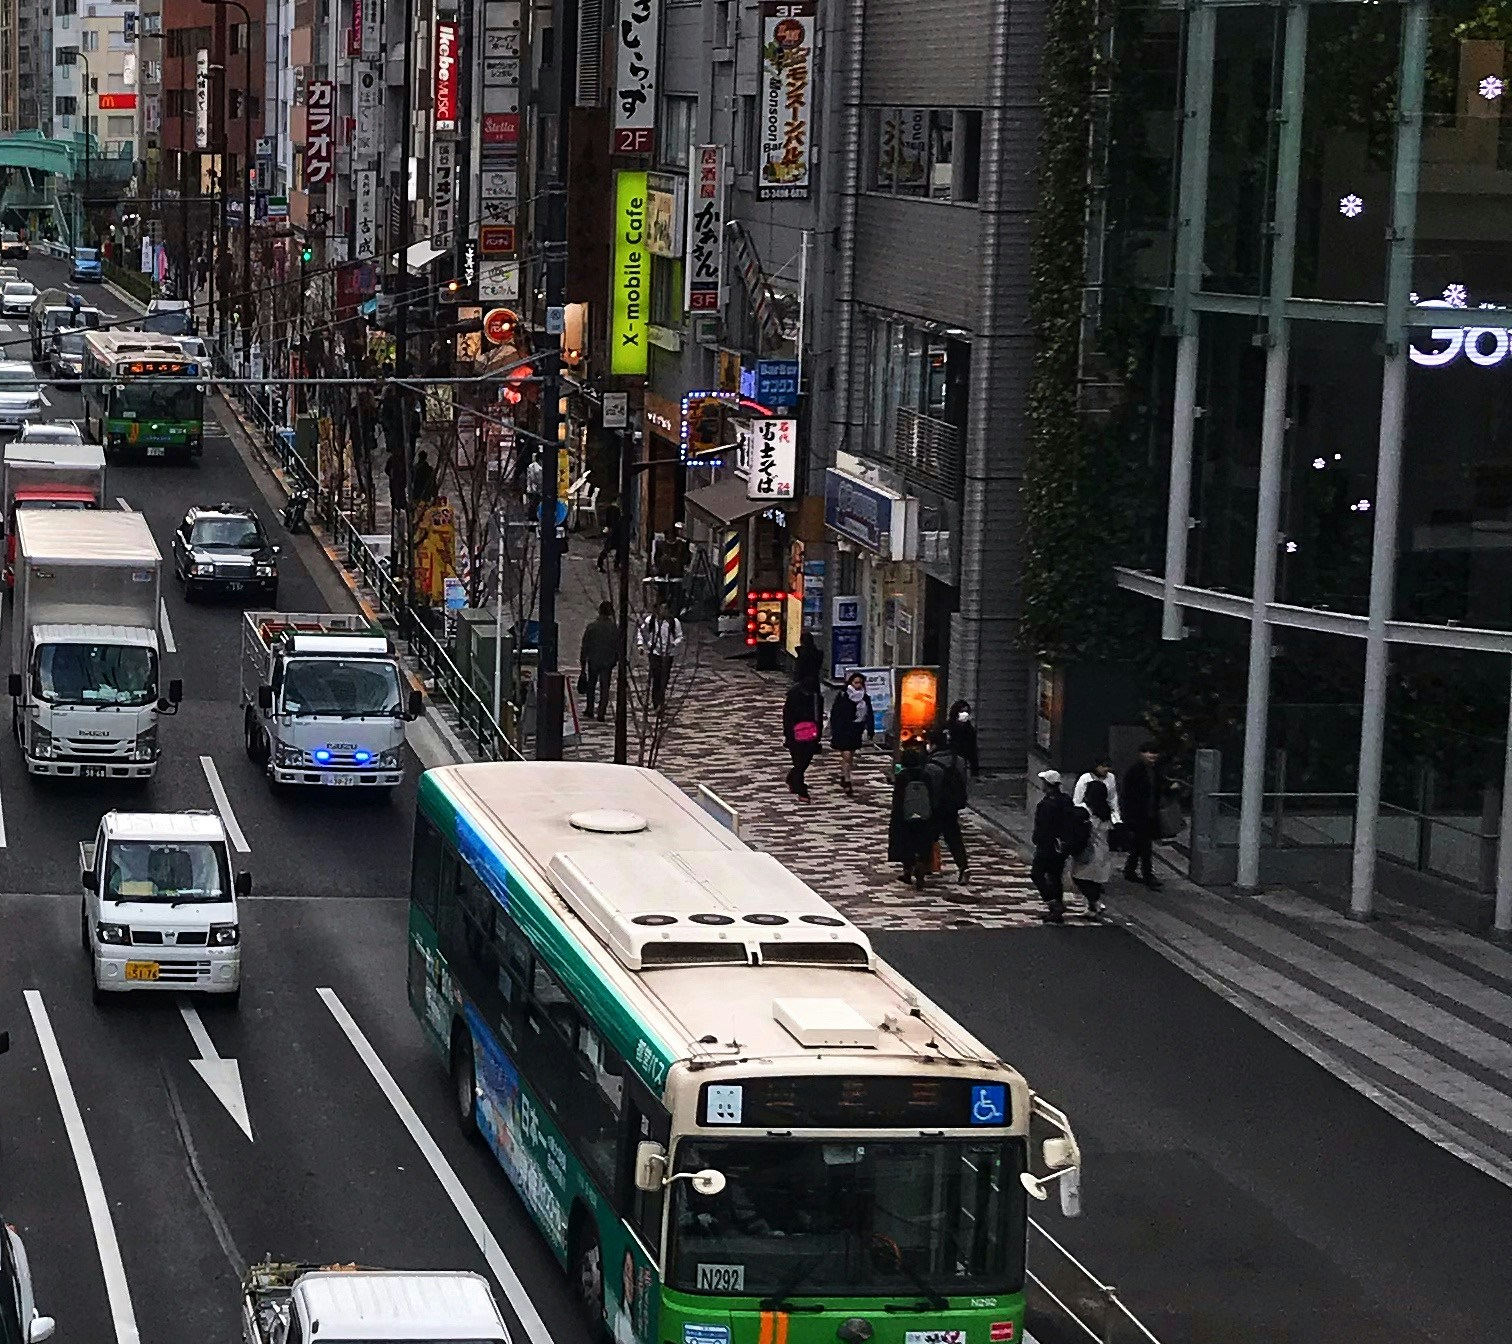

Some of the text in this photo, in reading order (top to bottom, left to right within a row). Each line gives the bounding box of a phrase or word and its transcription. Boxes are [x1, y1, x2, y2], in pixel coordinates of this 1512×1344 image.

[776, 5, 803, 17] 3F
[437, 25, 455, 118] Ikebe MUSIC
[307, 82, 331, 183] カラオケ
[485, 119, 515, 133] Stella
[620, 130, 648, 151] 2F
[700, 149, 717, 199] 居酒屋
[623, 197, 644, 347] X-mobile Cafe
[481, 286, 516, 296] てもみん
[693, 294, 716, 307] 3F
[758, 421, 778, 495] 富士そば
[701, 1267, 739, 1290] N292
